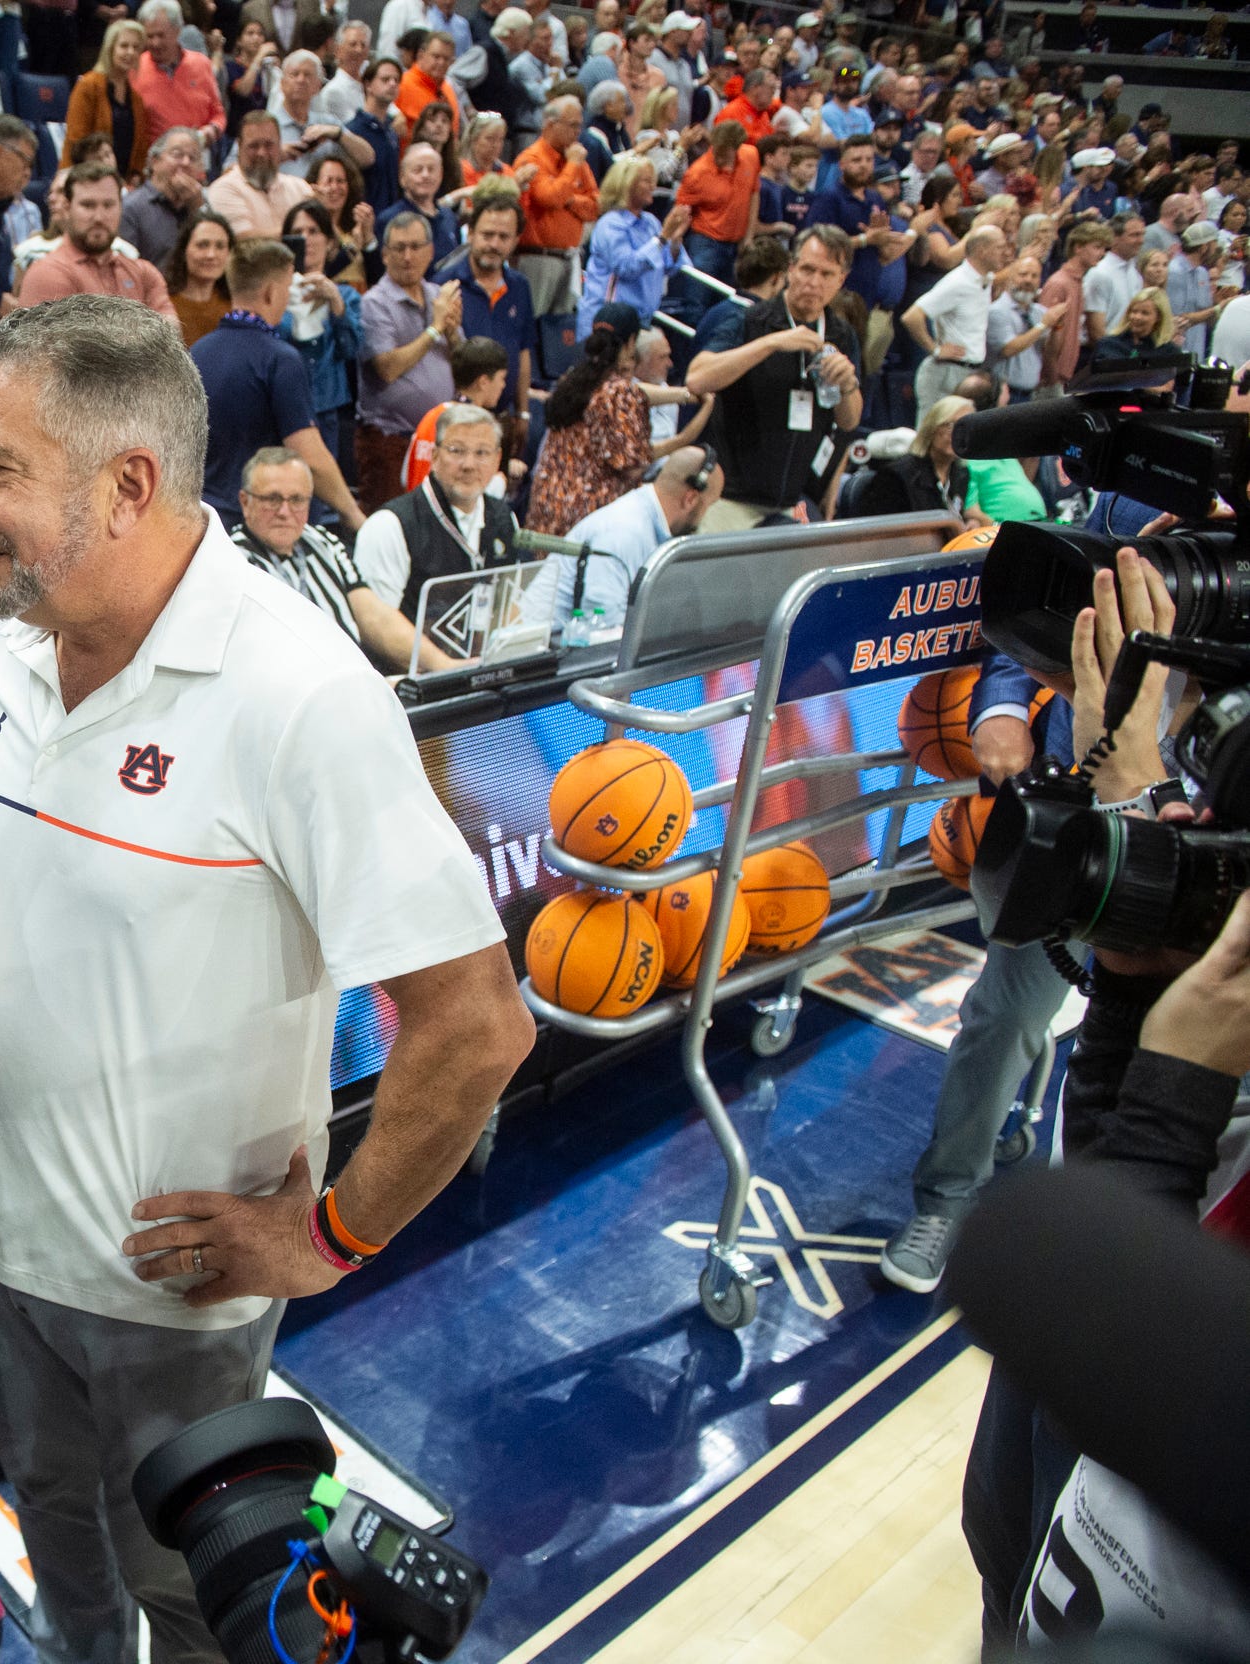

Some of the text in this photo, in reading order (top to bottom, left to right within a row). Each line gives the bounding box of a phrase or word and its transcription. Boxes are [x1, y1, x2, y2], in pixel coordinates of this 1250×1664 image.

[1065, 443, 1083, 459] JVC
[1125, 453, 1146, 470] 4K
[1120, 1571, 1166, 1620] ACCESS
